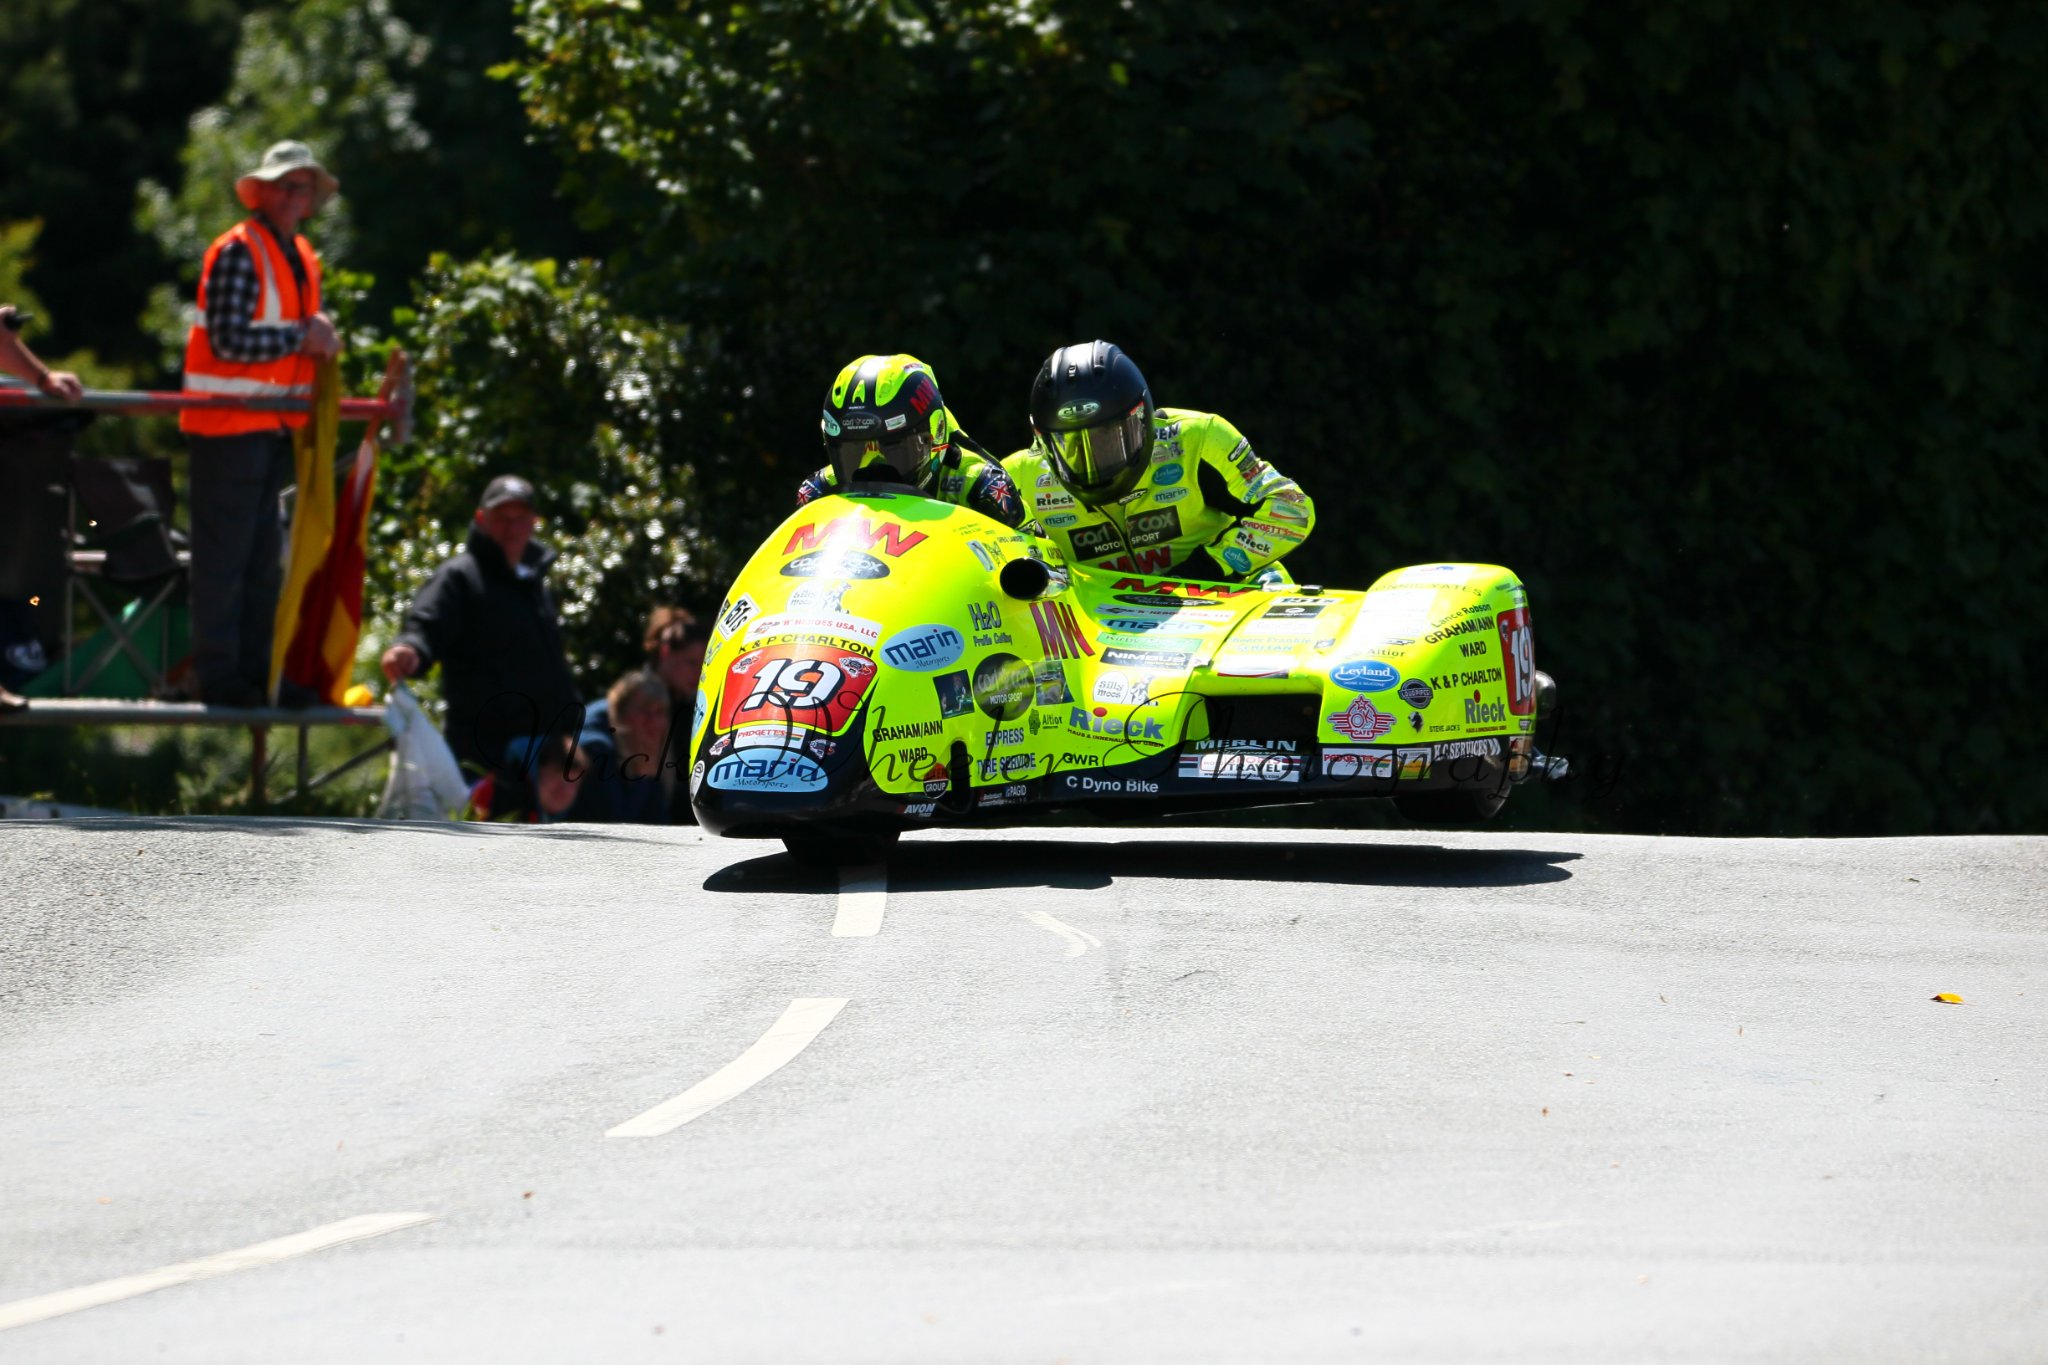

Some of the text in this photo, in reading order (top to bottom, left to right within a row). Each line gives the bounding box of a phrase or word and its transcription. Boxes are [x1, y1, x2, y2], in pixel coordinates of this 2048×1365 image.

[1037, 493, 1074, 506] Rieck
[1155, 488, 1187, 501] marin
[1044, 514, 1077, 525] marin
[782, 518, 929, 557] MW
[1237, 531, 1271, 554] Rieck
[1098, 545, 1172, 575] MW
[1110, 578, 1258, 598] MW
[1106, 619, 1206, 630] marin
[1431, 603, 1492, 628] Lance Robson
[861, 627, 878, 639] LLC
[1028, 601, 1096, 660] MW
[1424, 615, 1496, 644] GRAHAM/ANN
[739, 645, 748, 654] K
[766, 636, 777, 645] P
[781, 634, 875, 658] CHARLTON
[885, 628, 958, 665] marin
[1459, 640, 1487, 658] WARD
[1108, 651, 1185, 663] NIMBUS
[1510, 624, 1534, 705] 19
[1340, 665, 1391, 677] Leyland
[1430, 667, 1503, 690] K & P CHARLTON
[741, 658, 846, 712] 19
[1464, 688, 1507, 724] Rieck
[1042, 713, 1063, 725] Altior
[1069, 705, 1165, 740] Rieck
[872, 720, 944, 743] GRAHAM/ANN
[985, 727, 1025, 748] EXPRESS
[899, 746, 928, 763] WARD
[1195, 739, 1297, 752] MERLIN
[713, 757, 819, 783] marin
[977, 752, 1037, 775] TYRE SERVICE
[1229, 763, 1281, 773] TRAVEL
[732, 777, 789, 789] Motorsports
[925, 781, 947, 792] GROUP
[1082, 777, 1121, 793] Dyno
[1126, 780, 1159, 793] Bike
[904, 803, 936, 814] AVON
